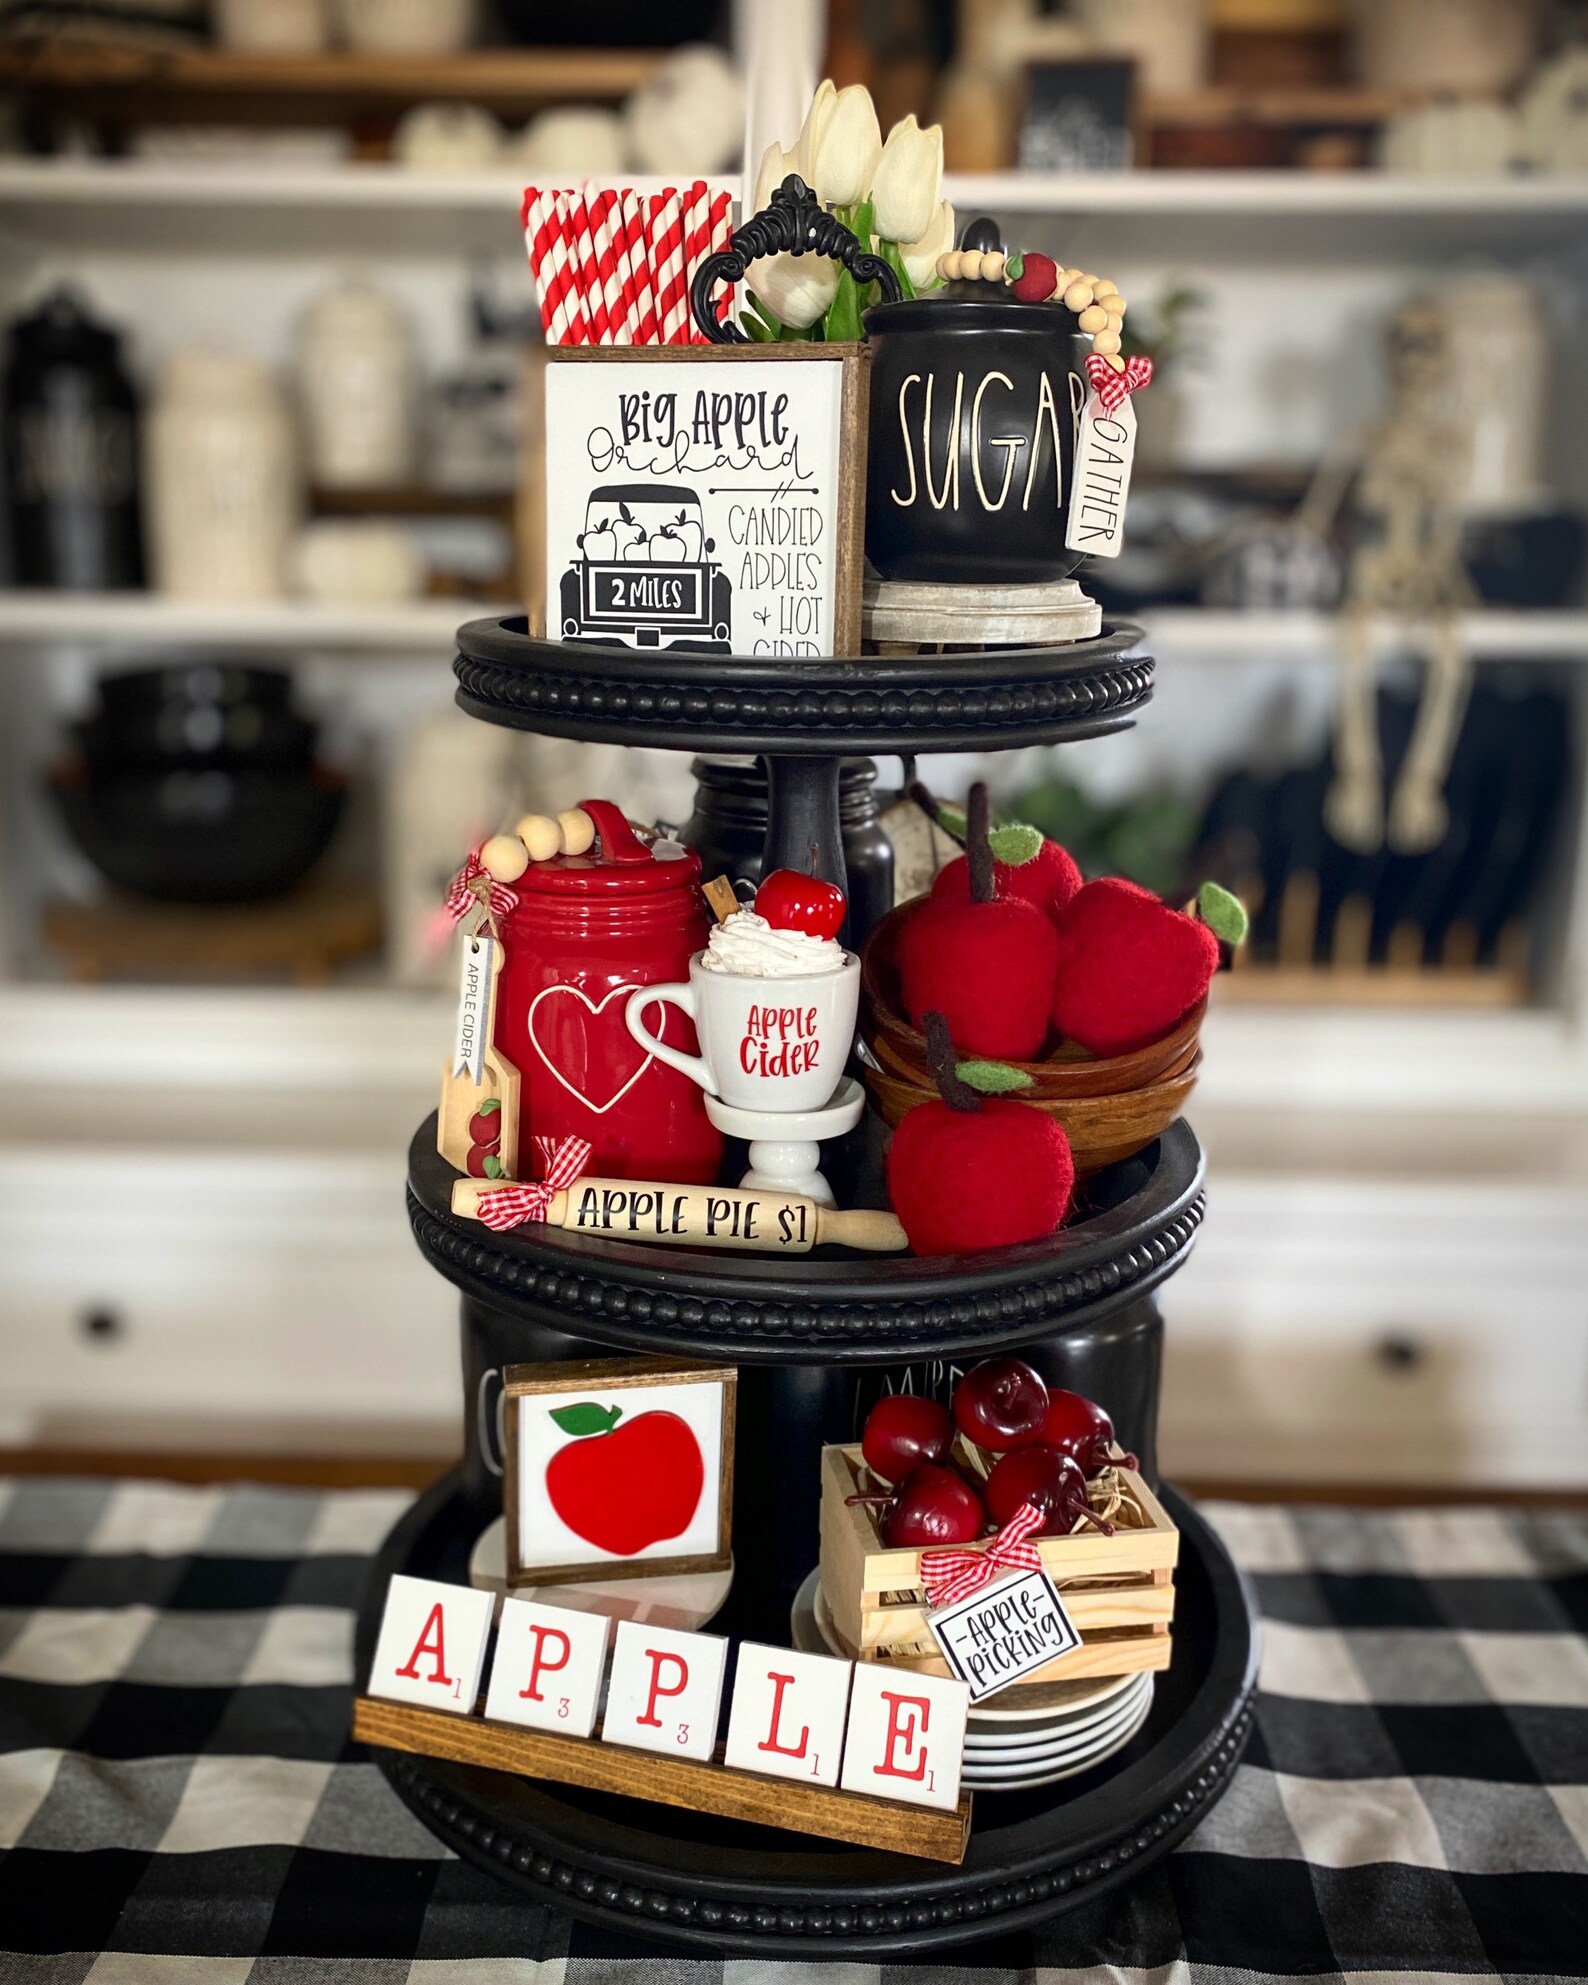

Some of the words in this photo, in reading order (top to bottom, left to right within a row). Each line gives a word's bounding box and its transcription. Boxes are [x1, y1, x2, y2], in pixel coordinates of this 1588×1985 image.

[587, 426, 815, 480] Orchard
[1077, 417, 1128, 542] GATHER
[728, 504, 824, 546] CANDIED
[611, 578, 626, 606] 2
[629, 575, 683, 609] MILES
[739, 551, 823, 591] APPLES
[779, 595, 823, 635] HOT
[464, 963, 479, 1011] APPLE
[460, 1014, 475, 1058] CIDER
[577, 1187, 689, 1234] APPLE
[706, 1197, 760, 1240] PIE
[777, 1204, 808, 1245] $1
